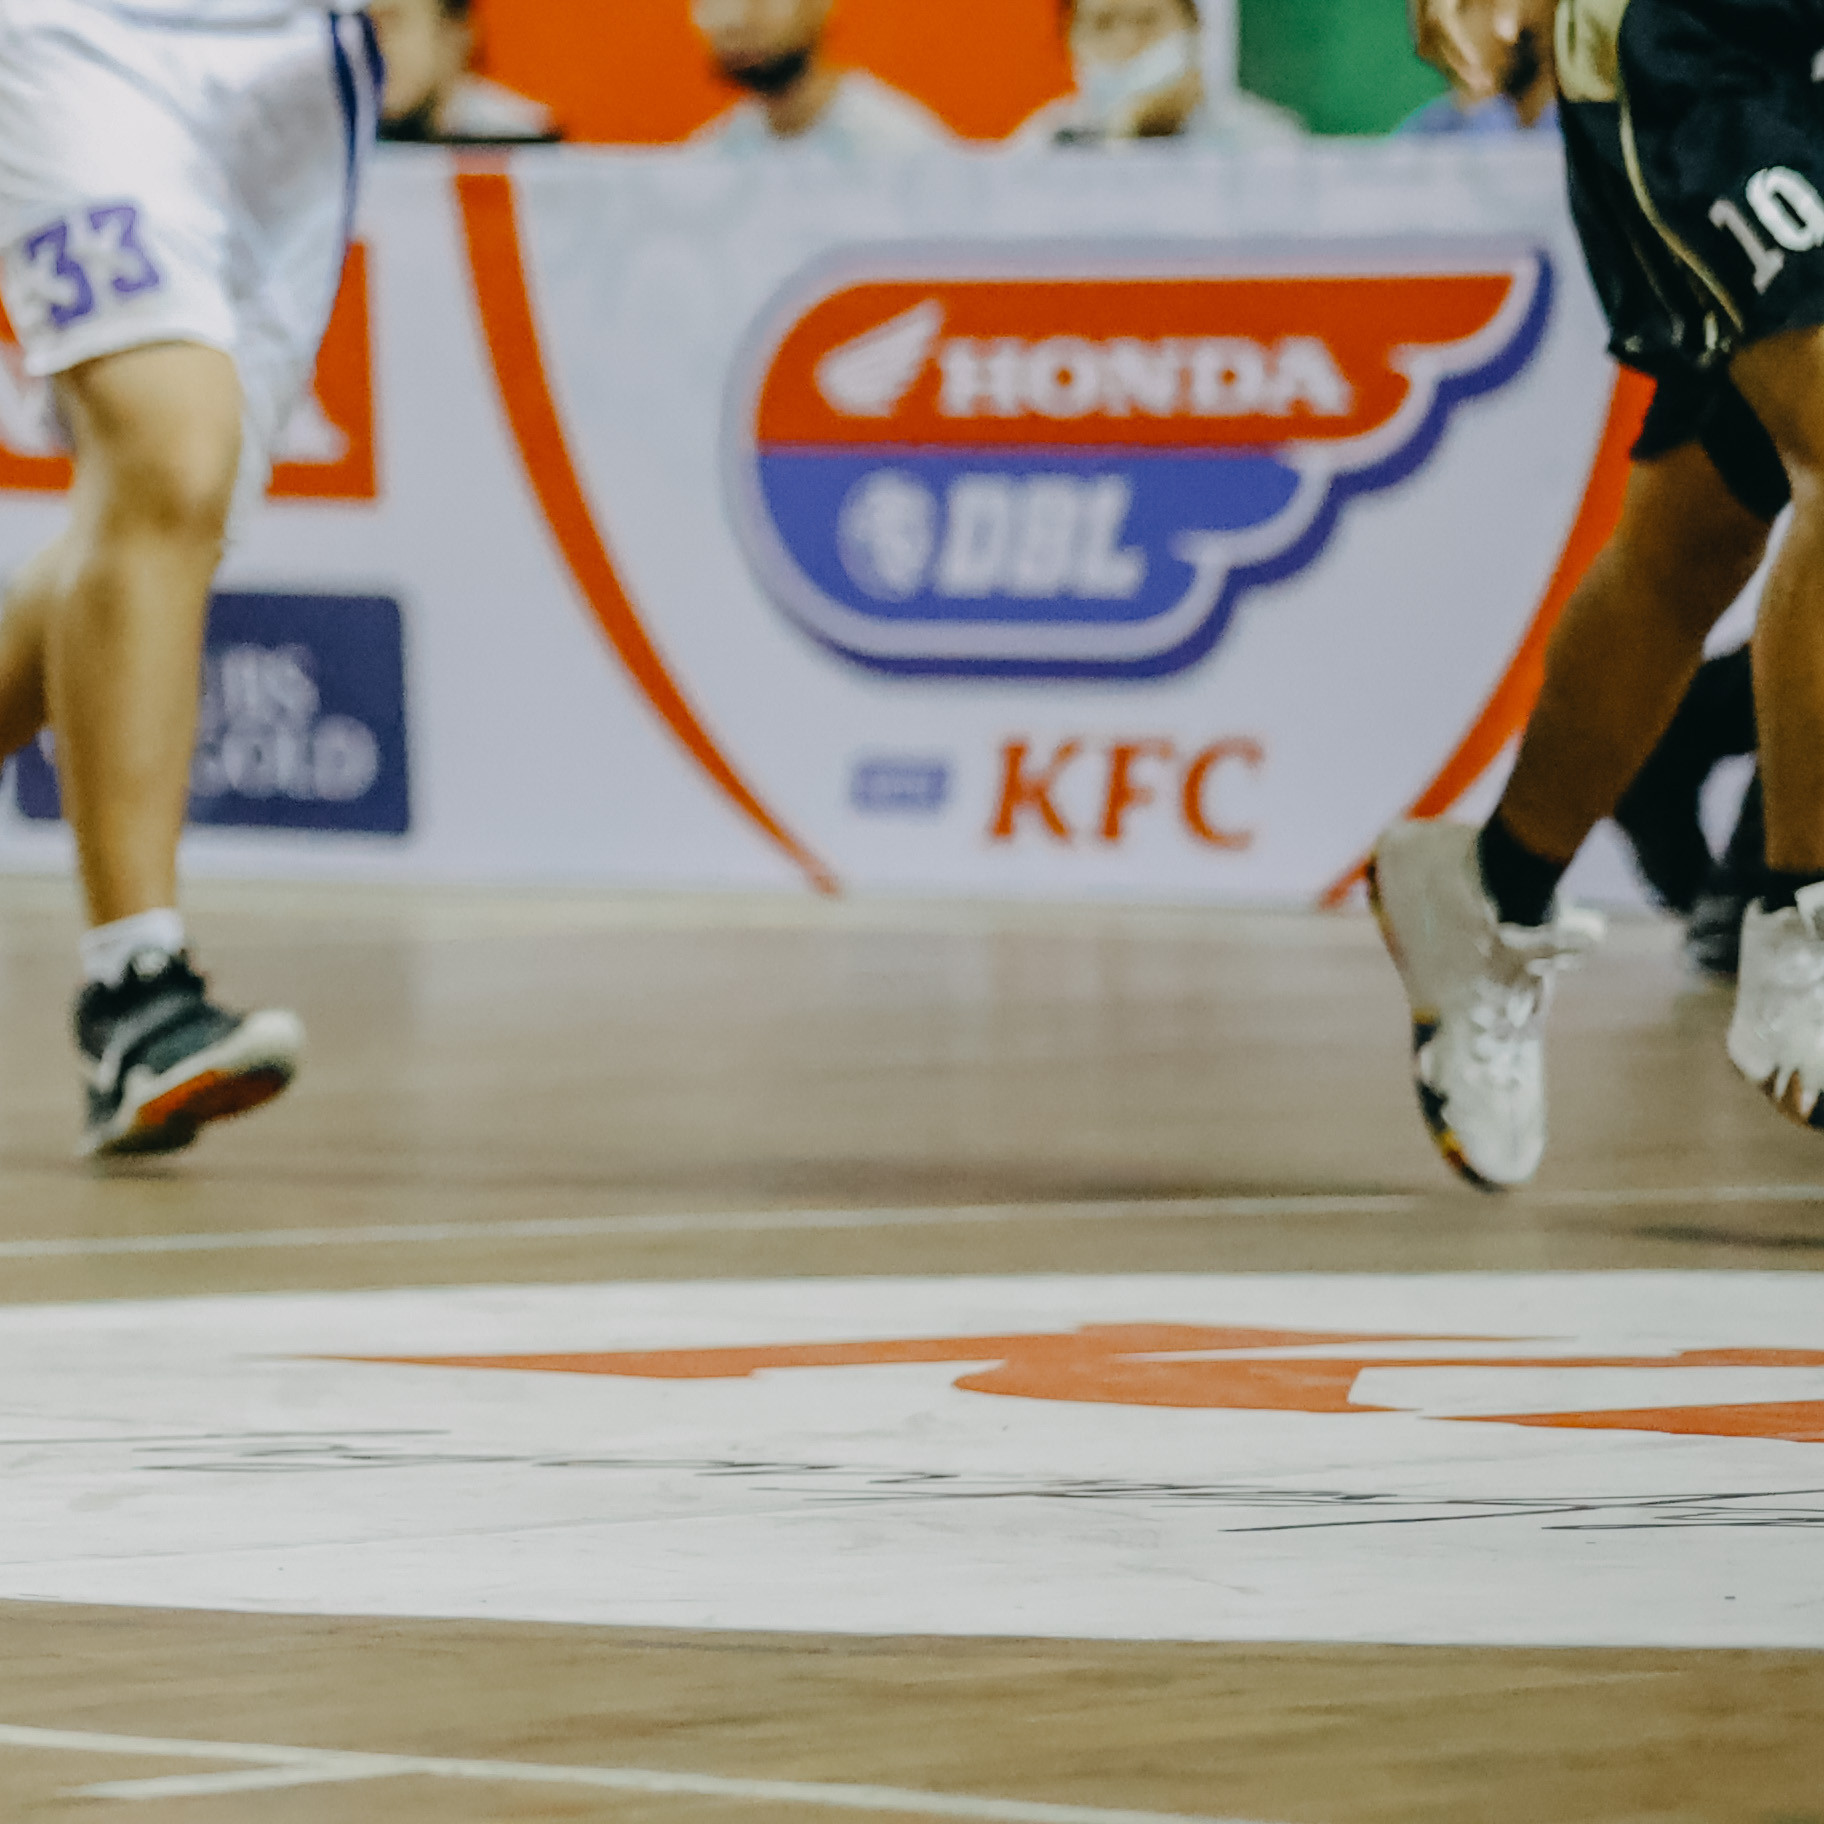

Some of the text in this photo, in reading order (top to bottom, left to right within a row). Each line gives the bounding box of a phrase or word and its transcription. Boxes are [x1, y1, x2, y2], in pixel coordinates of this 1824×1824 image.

[28, 205, 160, 326] 33
[1708, 165, 1824, 297] 10
[938, 334, 1354, 419] HONDA
[934, 476, 1146, 599] DBL
[988, 736, 1264, 850] KFC
